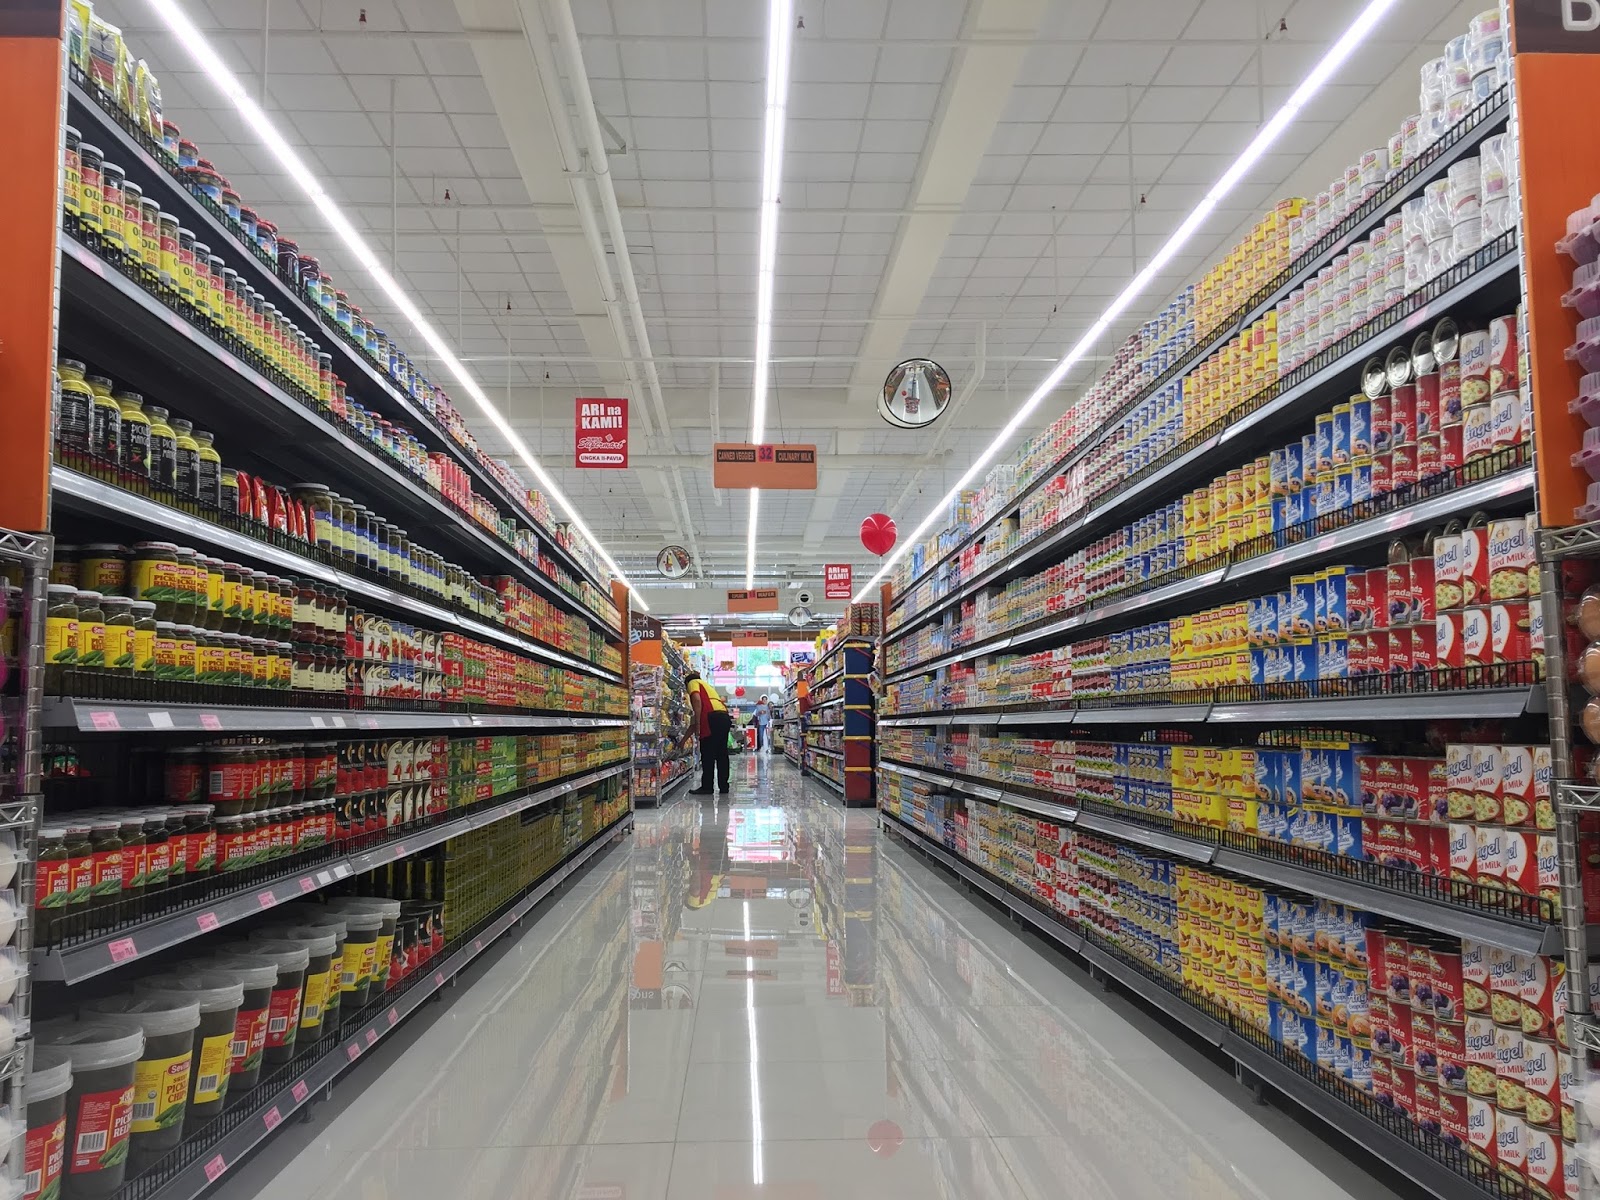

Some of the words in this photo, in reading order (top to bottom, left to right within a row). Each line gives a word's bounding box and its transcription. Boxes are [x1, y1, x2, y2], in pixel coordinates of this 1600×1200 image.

[581, 403, 605, 416] ARI
[607, 406, 621, 416] na
[581, 416, 623, 429] KAMI!
[1497, 426, 1514, 436] Milk
[718, 451, 735, 460] CANNED
[735, 451, 754, 461] VEGGIES
[759, 447, 772, 460] 32
[777, 452, 800, 461] CULINARY
[800, 453, 813, 462] MILK
[1506, 551, 1526, 564] Milk
[1442, 566, 1459, 578] Milk
[1456, 776, 1474, 785] Milk
[1480, 777, 1495, 786] Milk
[1508, 779, 1524, 789] Milk
[1454, 855, 1469, 864] Milk
[1484, 860, 1502, 870] Milk
[1468, 968, 1484, 977] Milk
[1500, 979, 1519, 988] Milk
[1523, 987, 1538, 997] Milk
[1478, 1051, 1497, 1060] Milk
[1507, 1064, 1525, 1074] Milk
[1531, 1077, 1548, 1086] Milk
[1472, 1132, 1487, 1141] Milk
[1503, 1149, 1521, 1159] Milk
[1532, 1165, 1548, 1176] Milk
